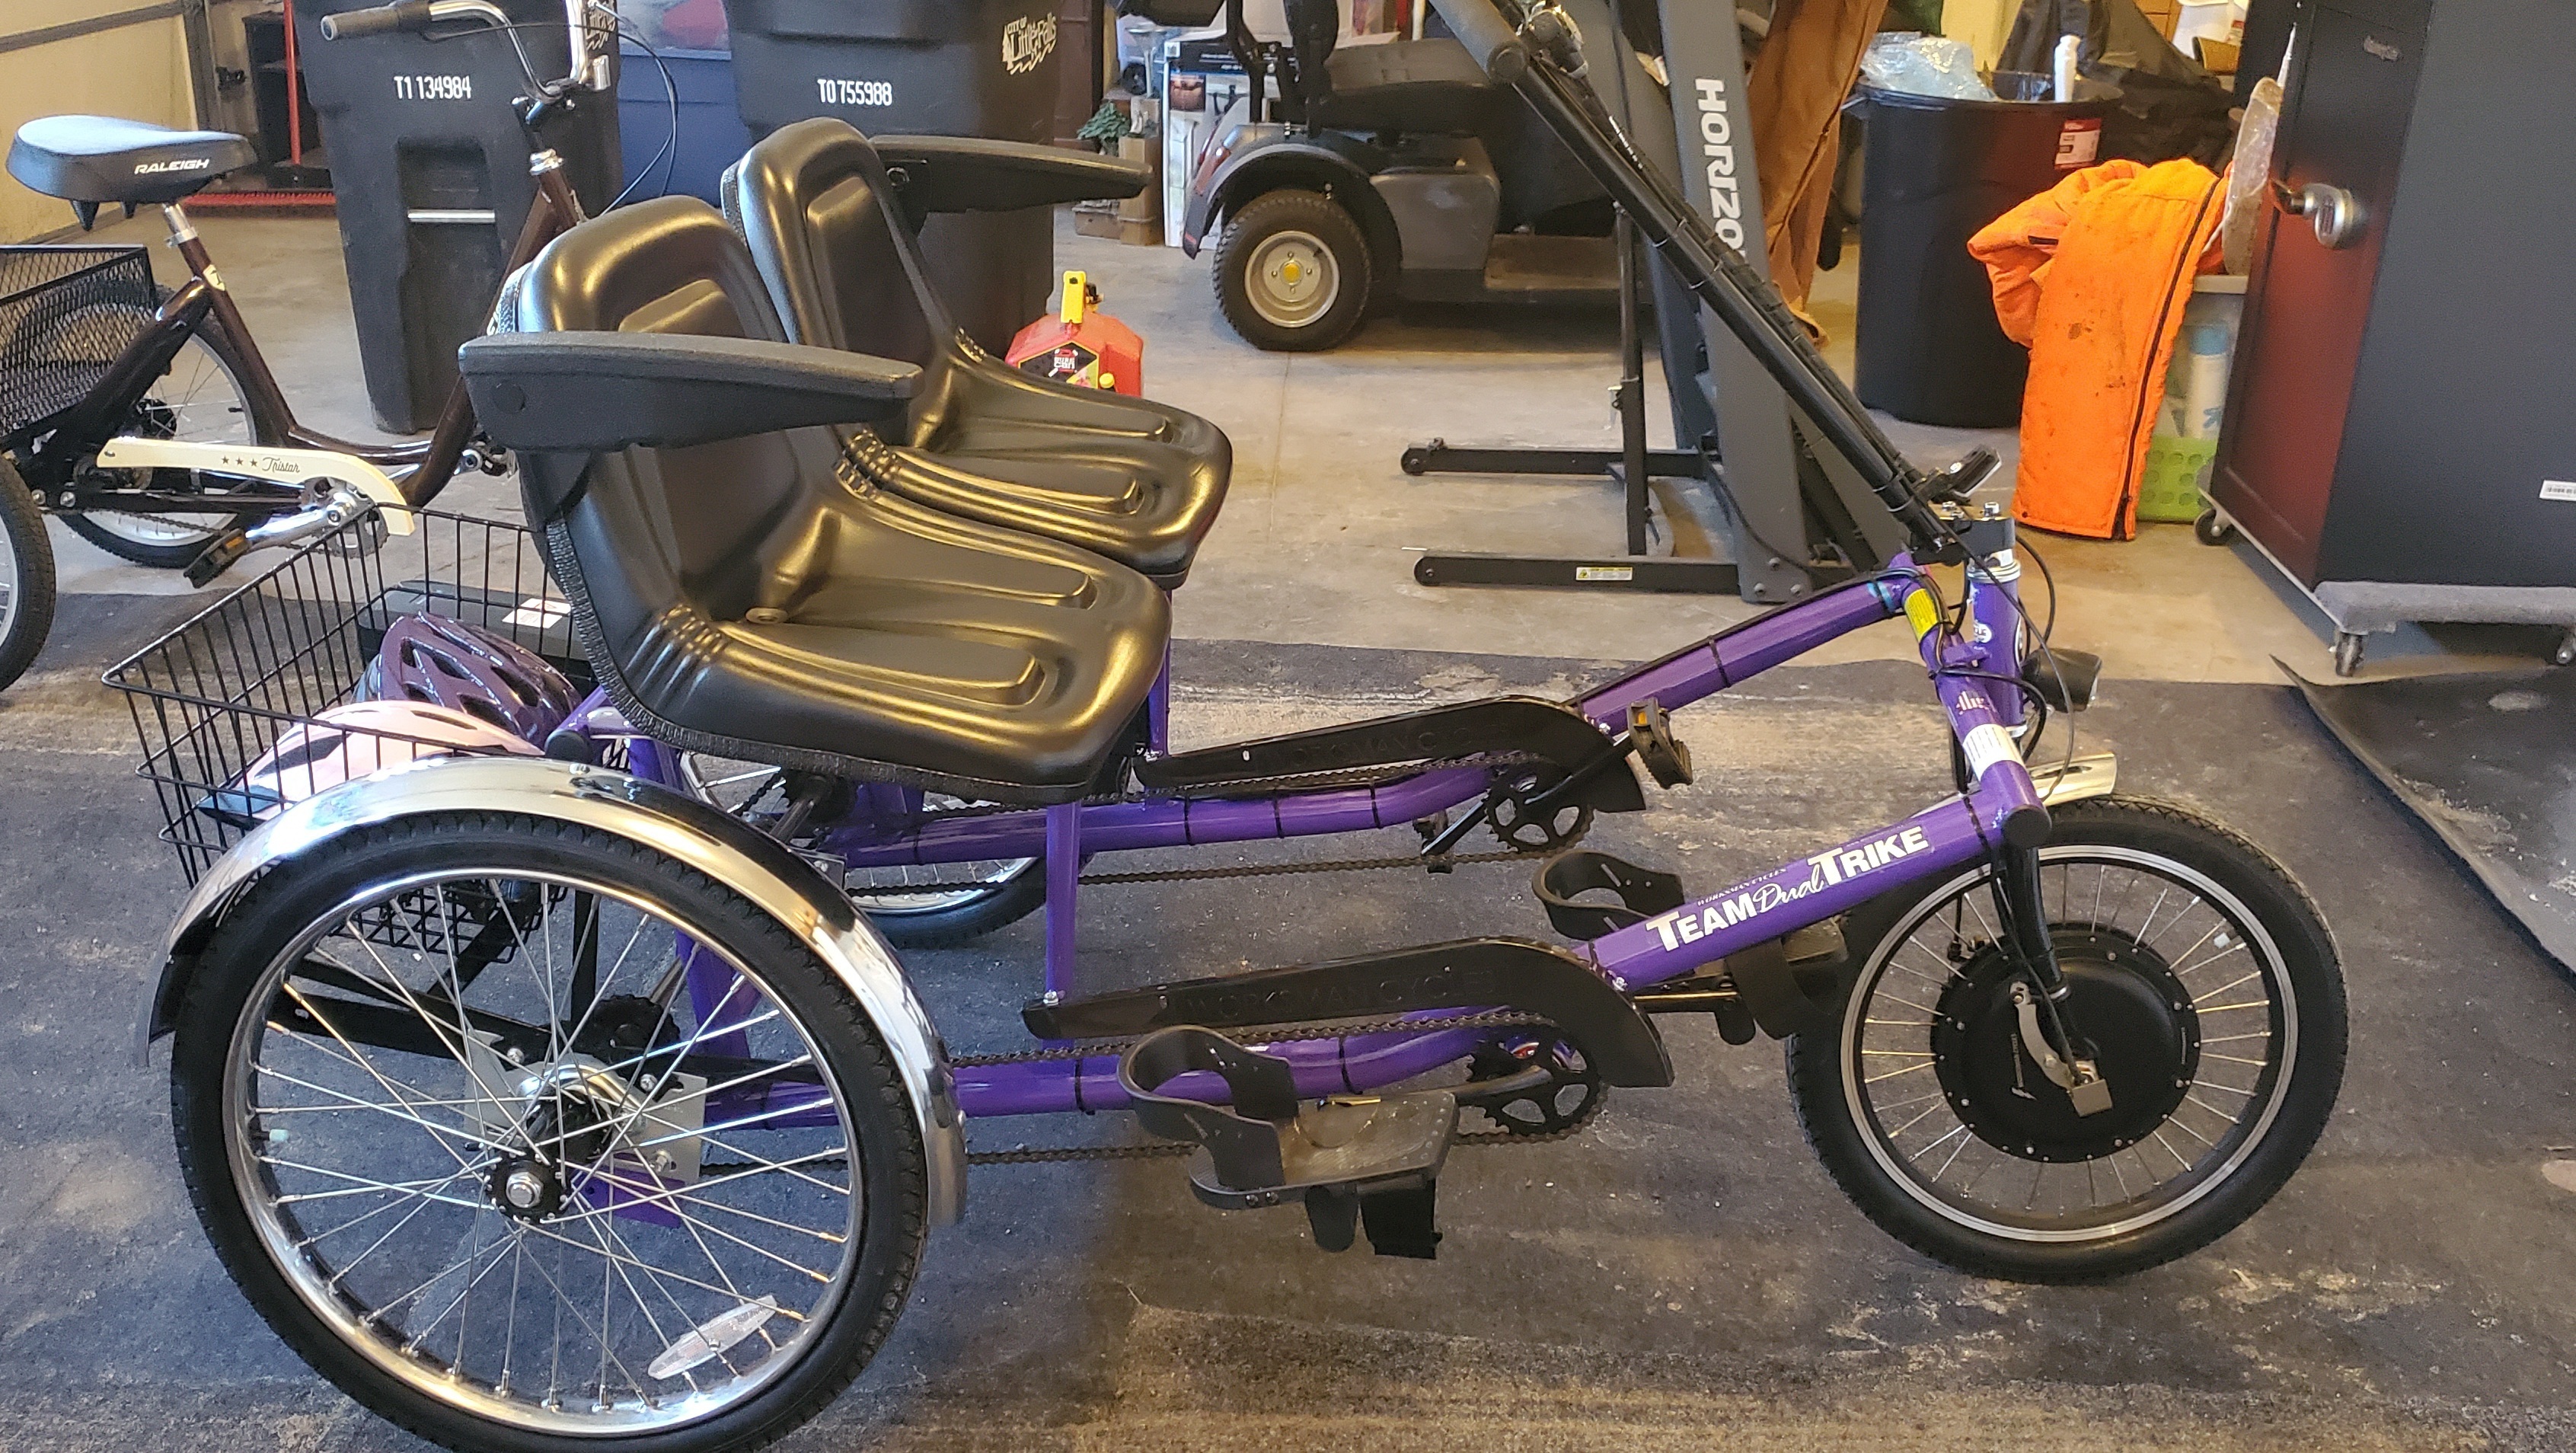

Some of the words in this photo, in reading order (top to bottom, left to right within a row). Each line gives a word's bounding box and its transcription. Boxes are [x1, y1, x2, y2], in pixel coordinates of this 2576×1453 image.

[1010, 24, 1038, 61] Little
[394, 75, 413, 100] T1
[416, 75, 471, 100] 134984
[837, 79, 892, 106] 755988
[134, 158, 209, 175] RALEIGH
[1694, 78, 1746, 257] HORIZO
[262, 457, 300, 473] Tristar
[1646, 892, 1757, 953] TEAM
[1752, 864, 1825, 914] Dual
[1808, 825, 1930, 886] TRIKE
